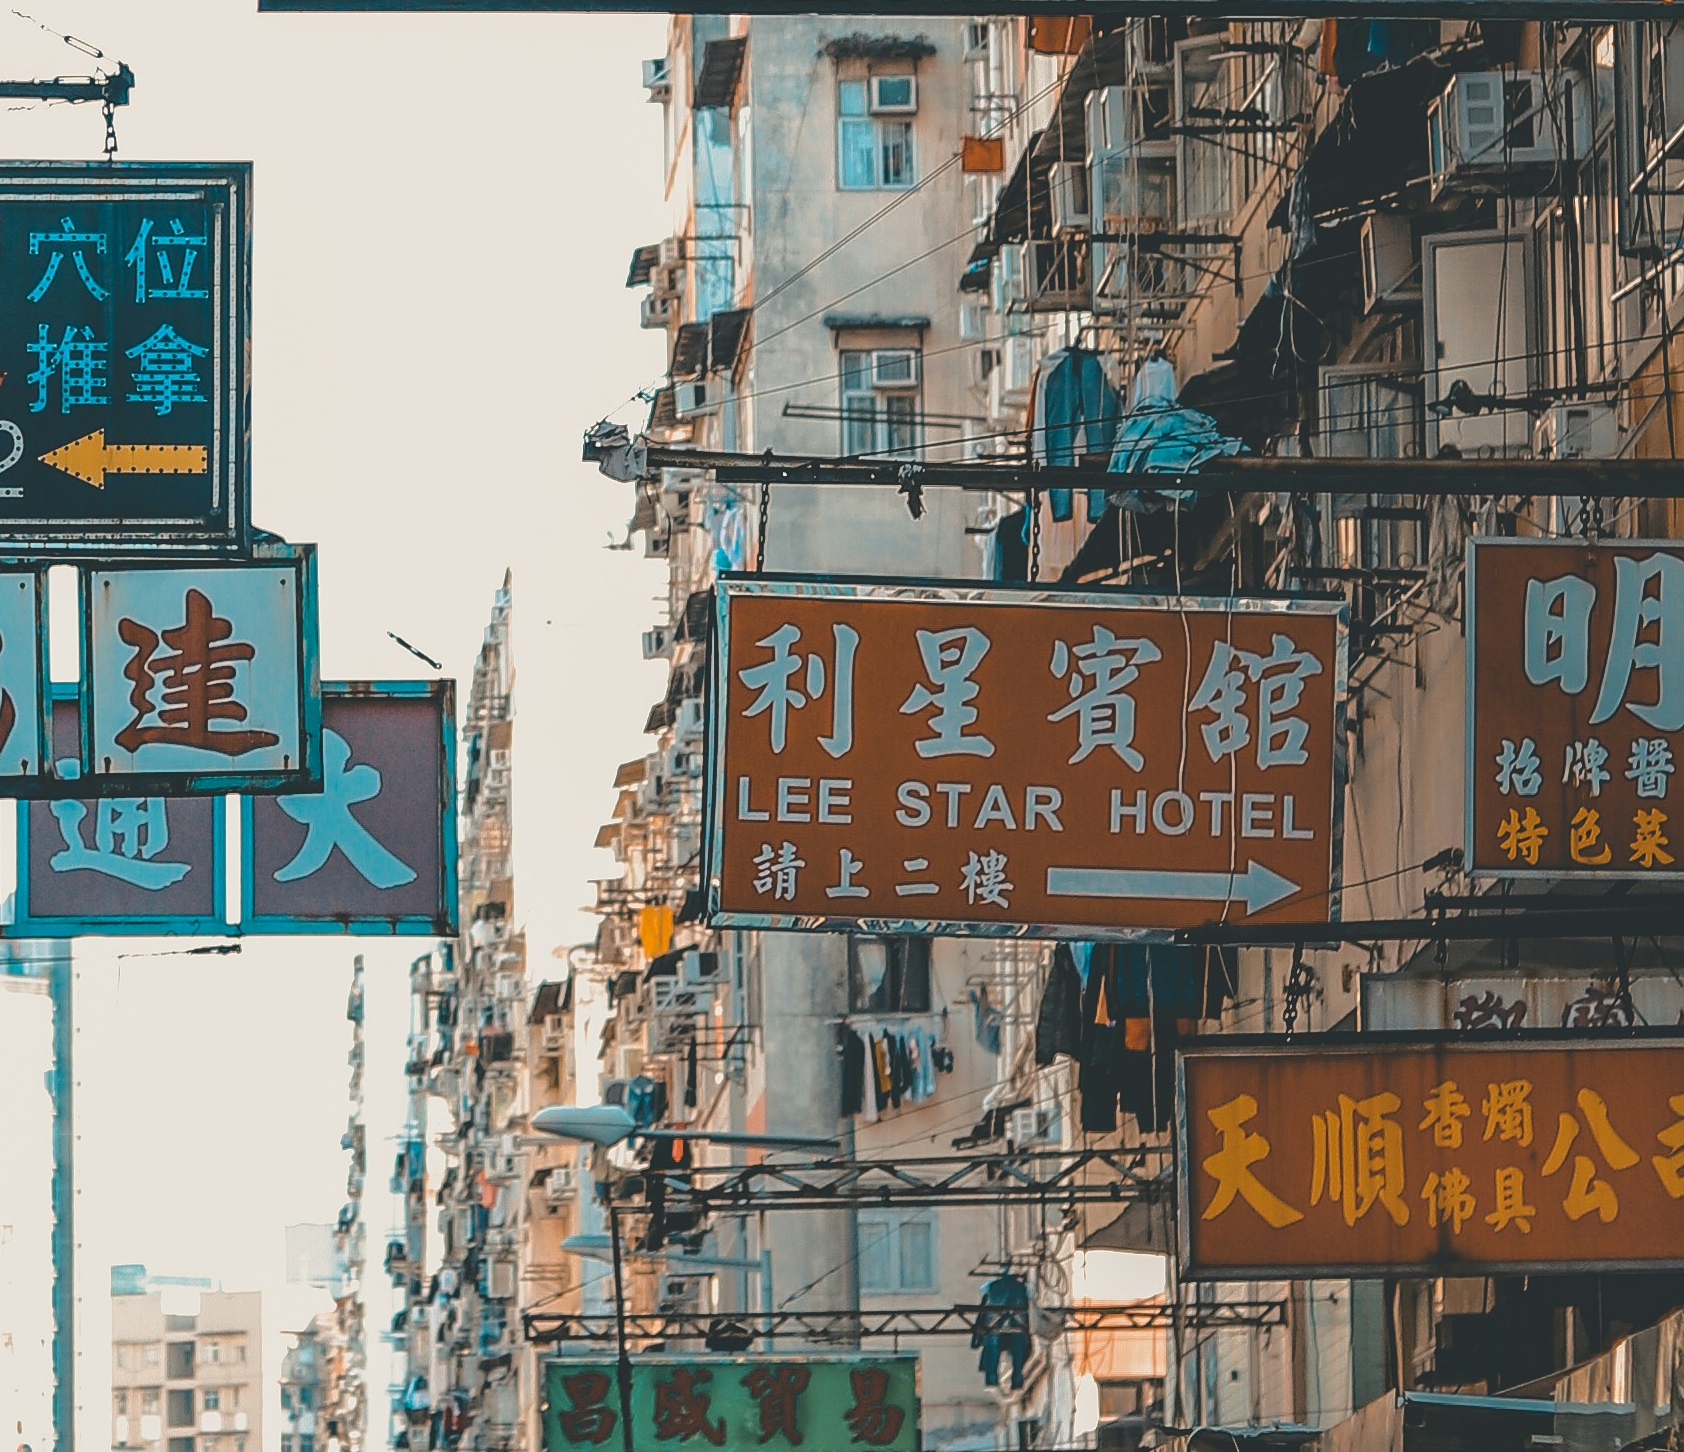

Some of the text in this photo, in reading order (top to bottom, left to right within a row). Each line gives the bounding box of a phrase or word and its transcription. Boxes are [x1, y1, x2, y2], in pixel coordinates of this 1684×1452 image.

[27, 216, 209, 304] 穴位
[27, 323, 209, 416] 推拿
[737, 776, 1315, 841] LEE STAR HOTEL
[1497, 806, 1676, 870] 特色菜
[751, 840, 1016, 910] 請上二樓
[558, 1366, 907, 1448] 昌盛貿易
